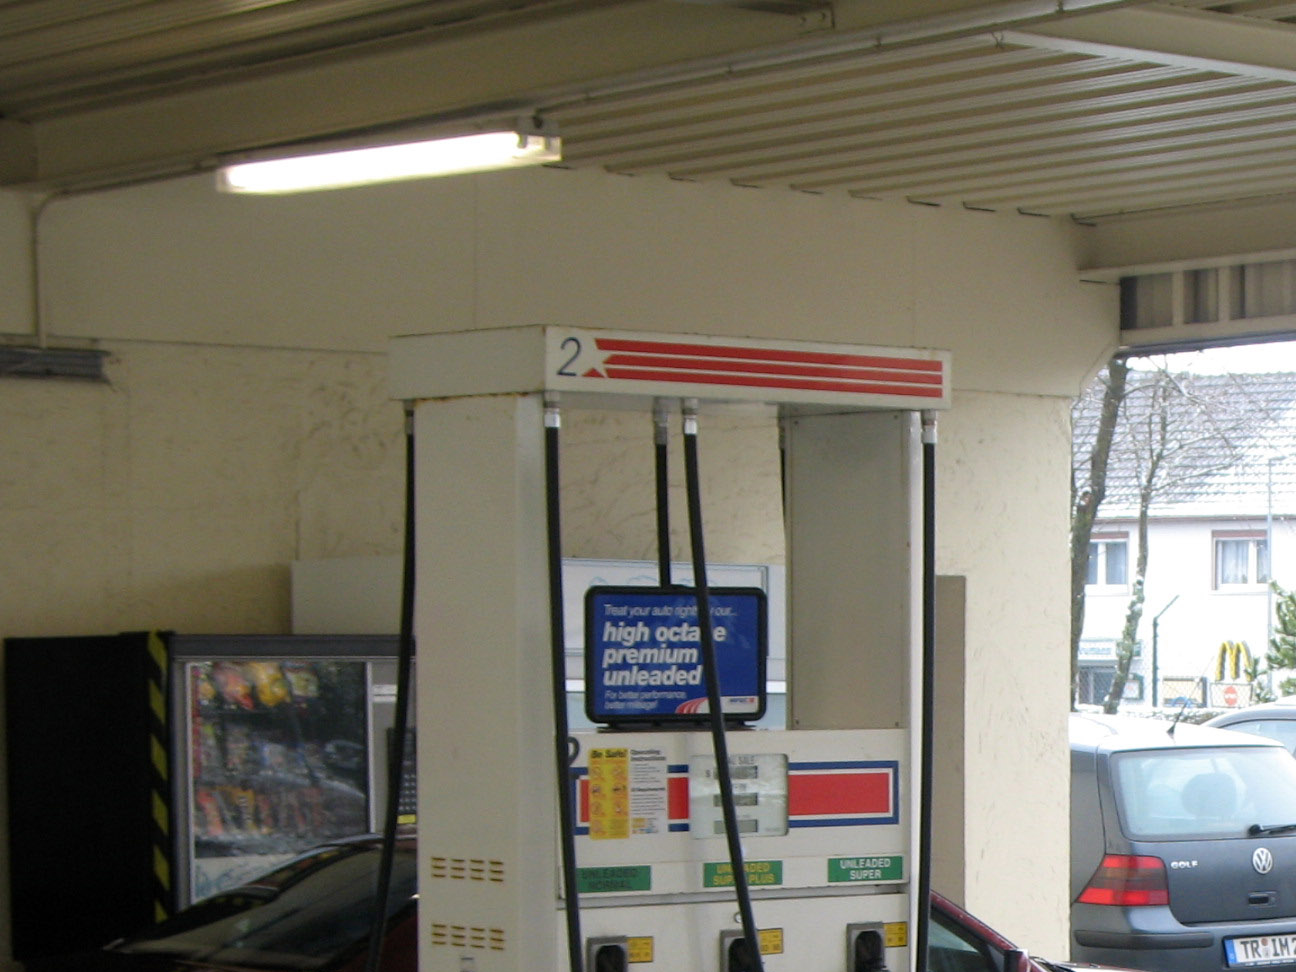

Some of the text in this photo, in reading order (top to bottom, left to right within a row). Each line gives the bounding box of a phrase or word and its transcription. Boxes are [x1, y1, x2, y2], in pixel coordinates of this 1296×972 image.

[556, 336, 581, 377] 2
[603, 604, 628, 617] Treat
[628, 606, 650, 618] your
[651, 605, 673, 617] auto
[602, 621, 728, 647] high octae
[602, 643, 699, 668] premium
[603, 664, 704, 686] unleaded
[716, 862, 770, 874] UNADED
[839, 857, 891, 870] UNLEADED
[1170, 859, 1199, 870] GOLF
[748, 873, 775, 885] PLUS
[849, 868, 882, 881] SUPER
[1240, 937, 1263, 960] TR
